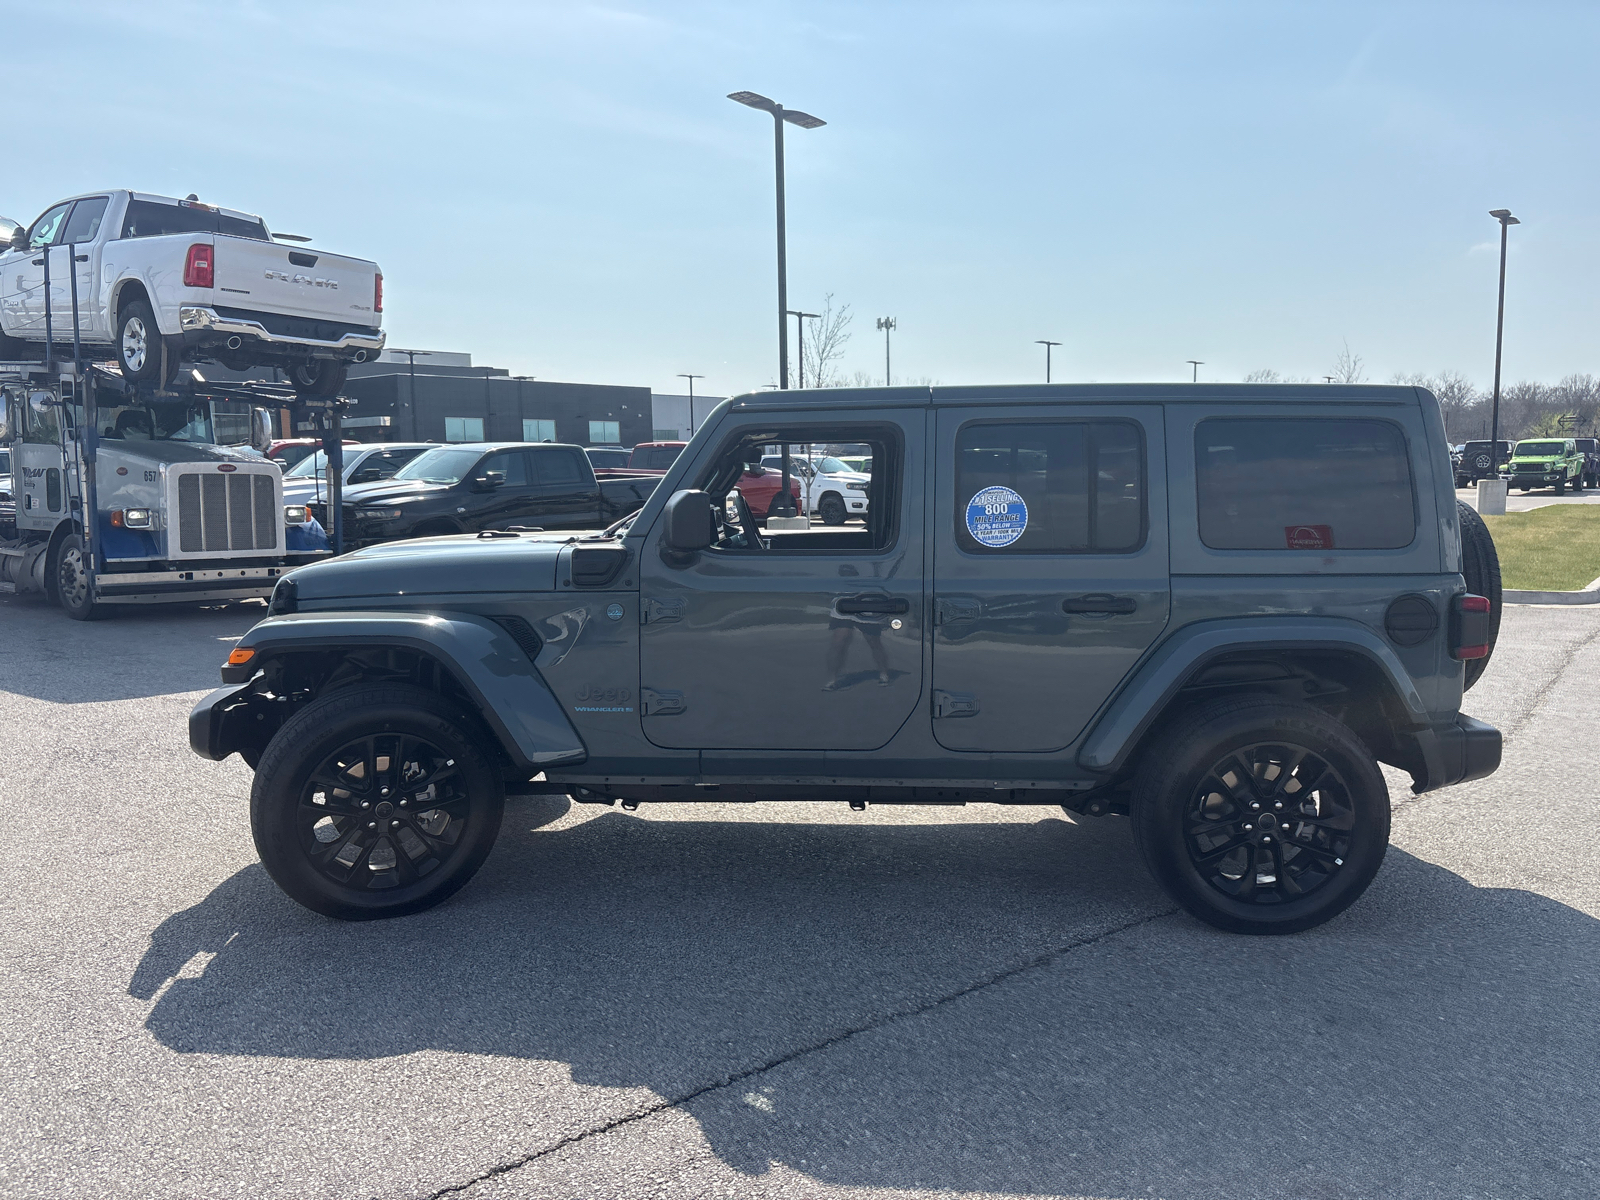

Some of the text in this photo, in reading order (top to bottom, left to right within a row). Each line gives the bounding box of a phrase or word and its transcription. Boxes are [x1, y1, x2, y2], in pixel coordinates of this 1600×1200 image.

[264, 268, 339, 290] RAM
[143, 470, 157, 482] 657
[987, 493, 1018, 503] SELLING
[985, 503, 1008, 515] 800
[975, 513, 1019, 523] MILE RANGE
[575, 683, 631, 705] Jeep
